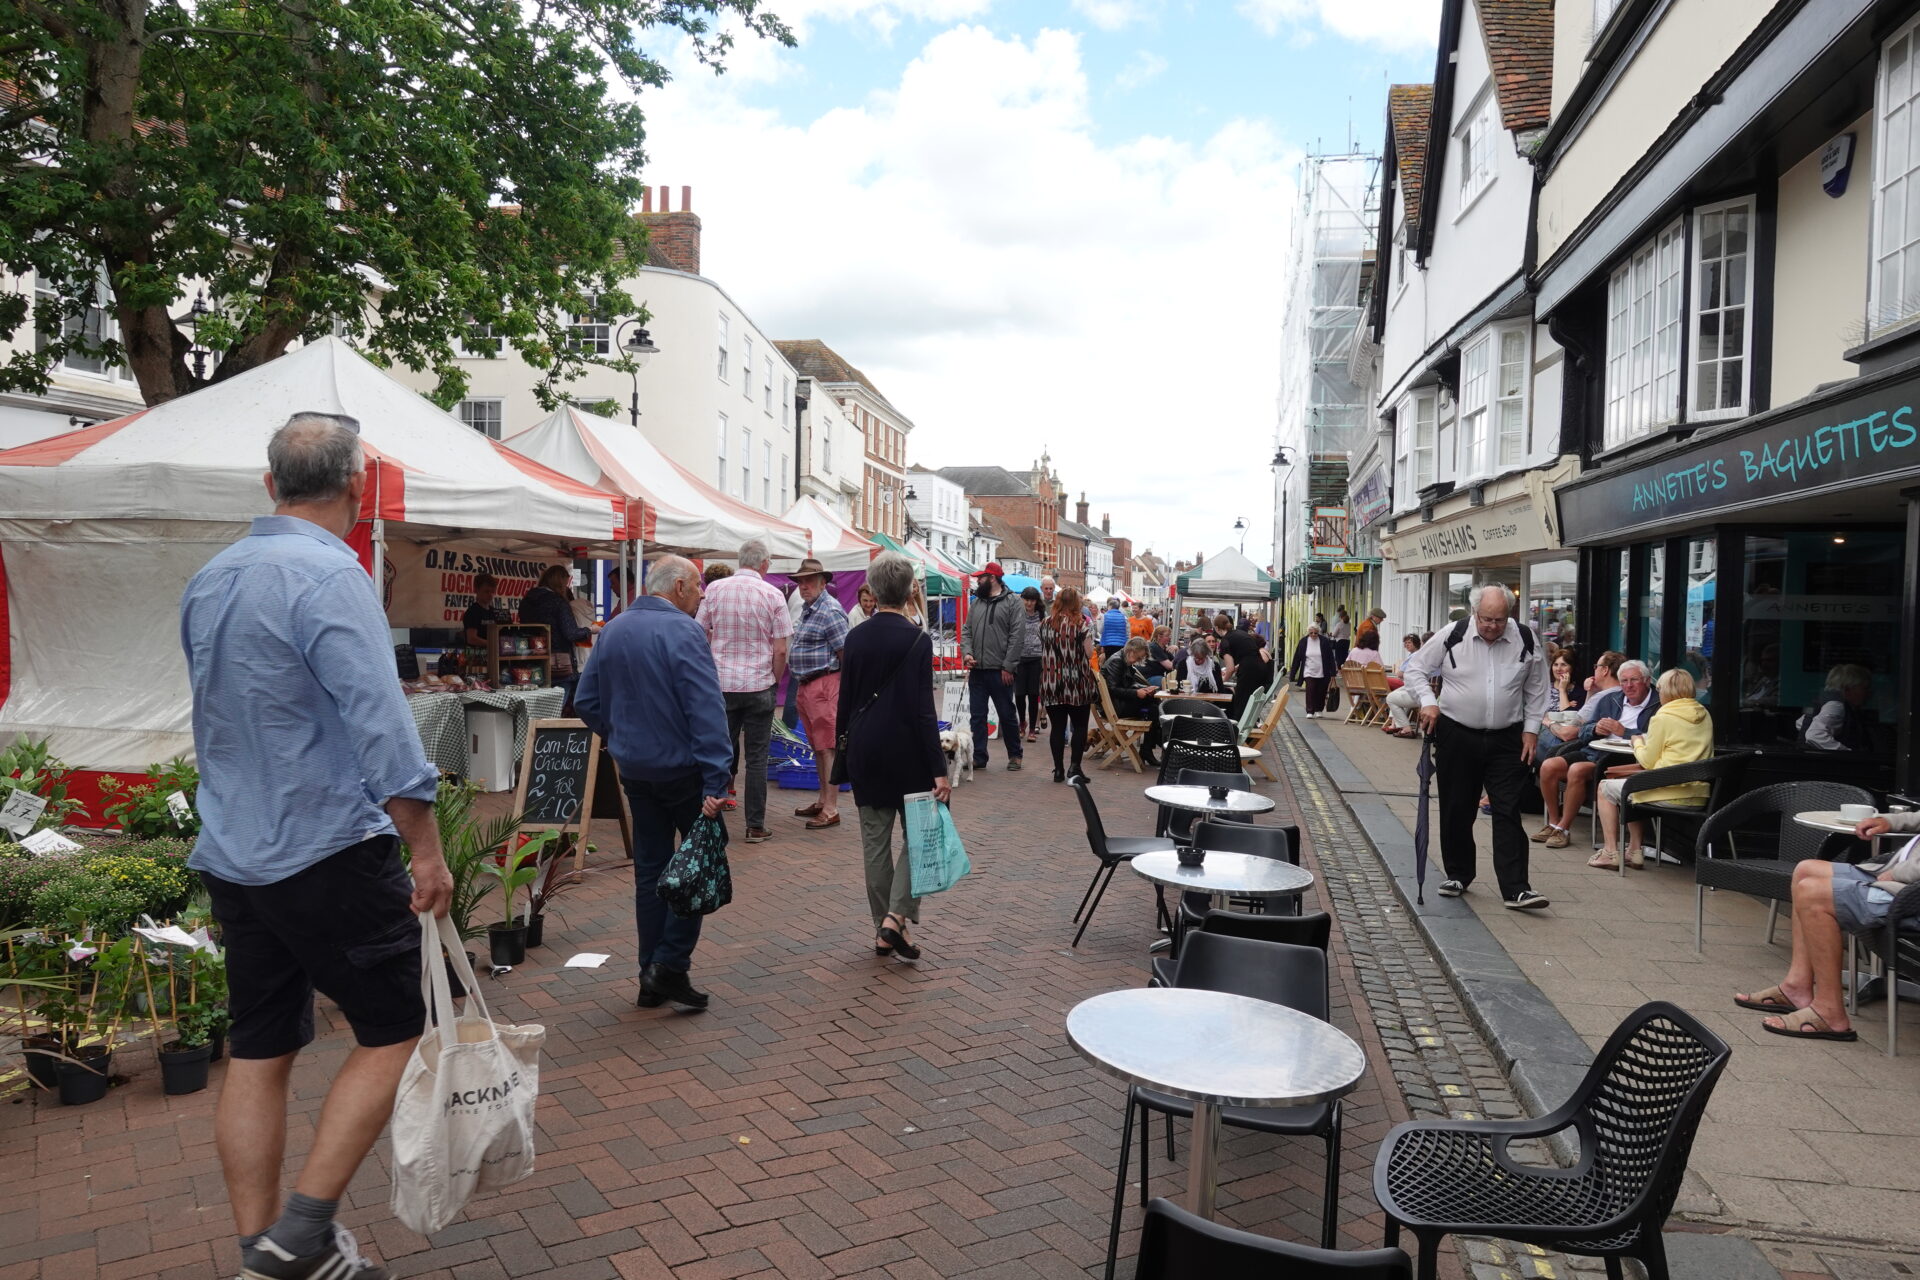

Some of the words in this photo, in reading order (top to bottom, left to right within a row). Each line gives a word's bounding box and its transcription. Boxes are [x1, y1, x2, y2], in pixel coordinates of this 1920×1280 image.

[1632, 459, 1728, 512] ANNETTE'S
[1740, 406, 1918, 482] BAGUETTES
[1419, 524, 1477, 559] HAVISHAMS
[1767, 602, 1871, 614] ANNETTE'S
[534, 754, 583, 771] Chicken
[528, 773, 546, 797] 2
[537, 796, 579, 820] £10
